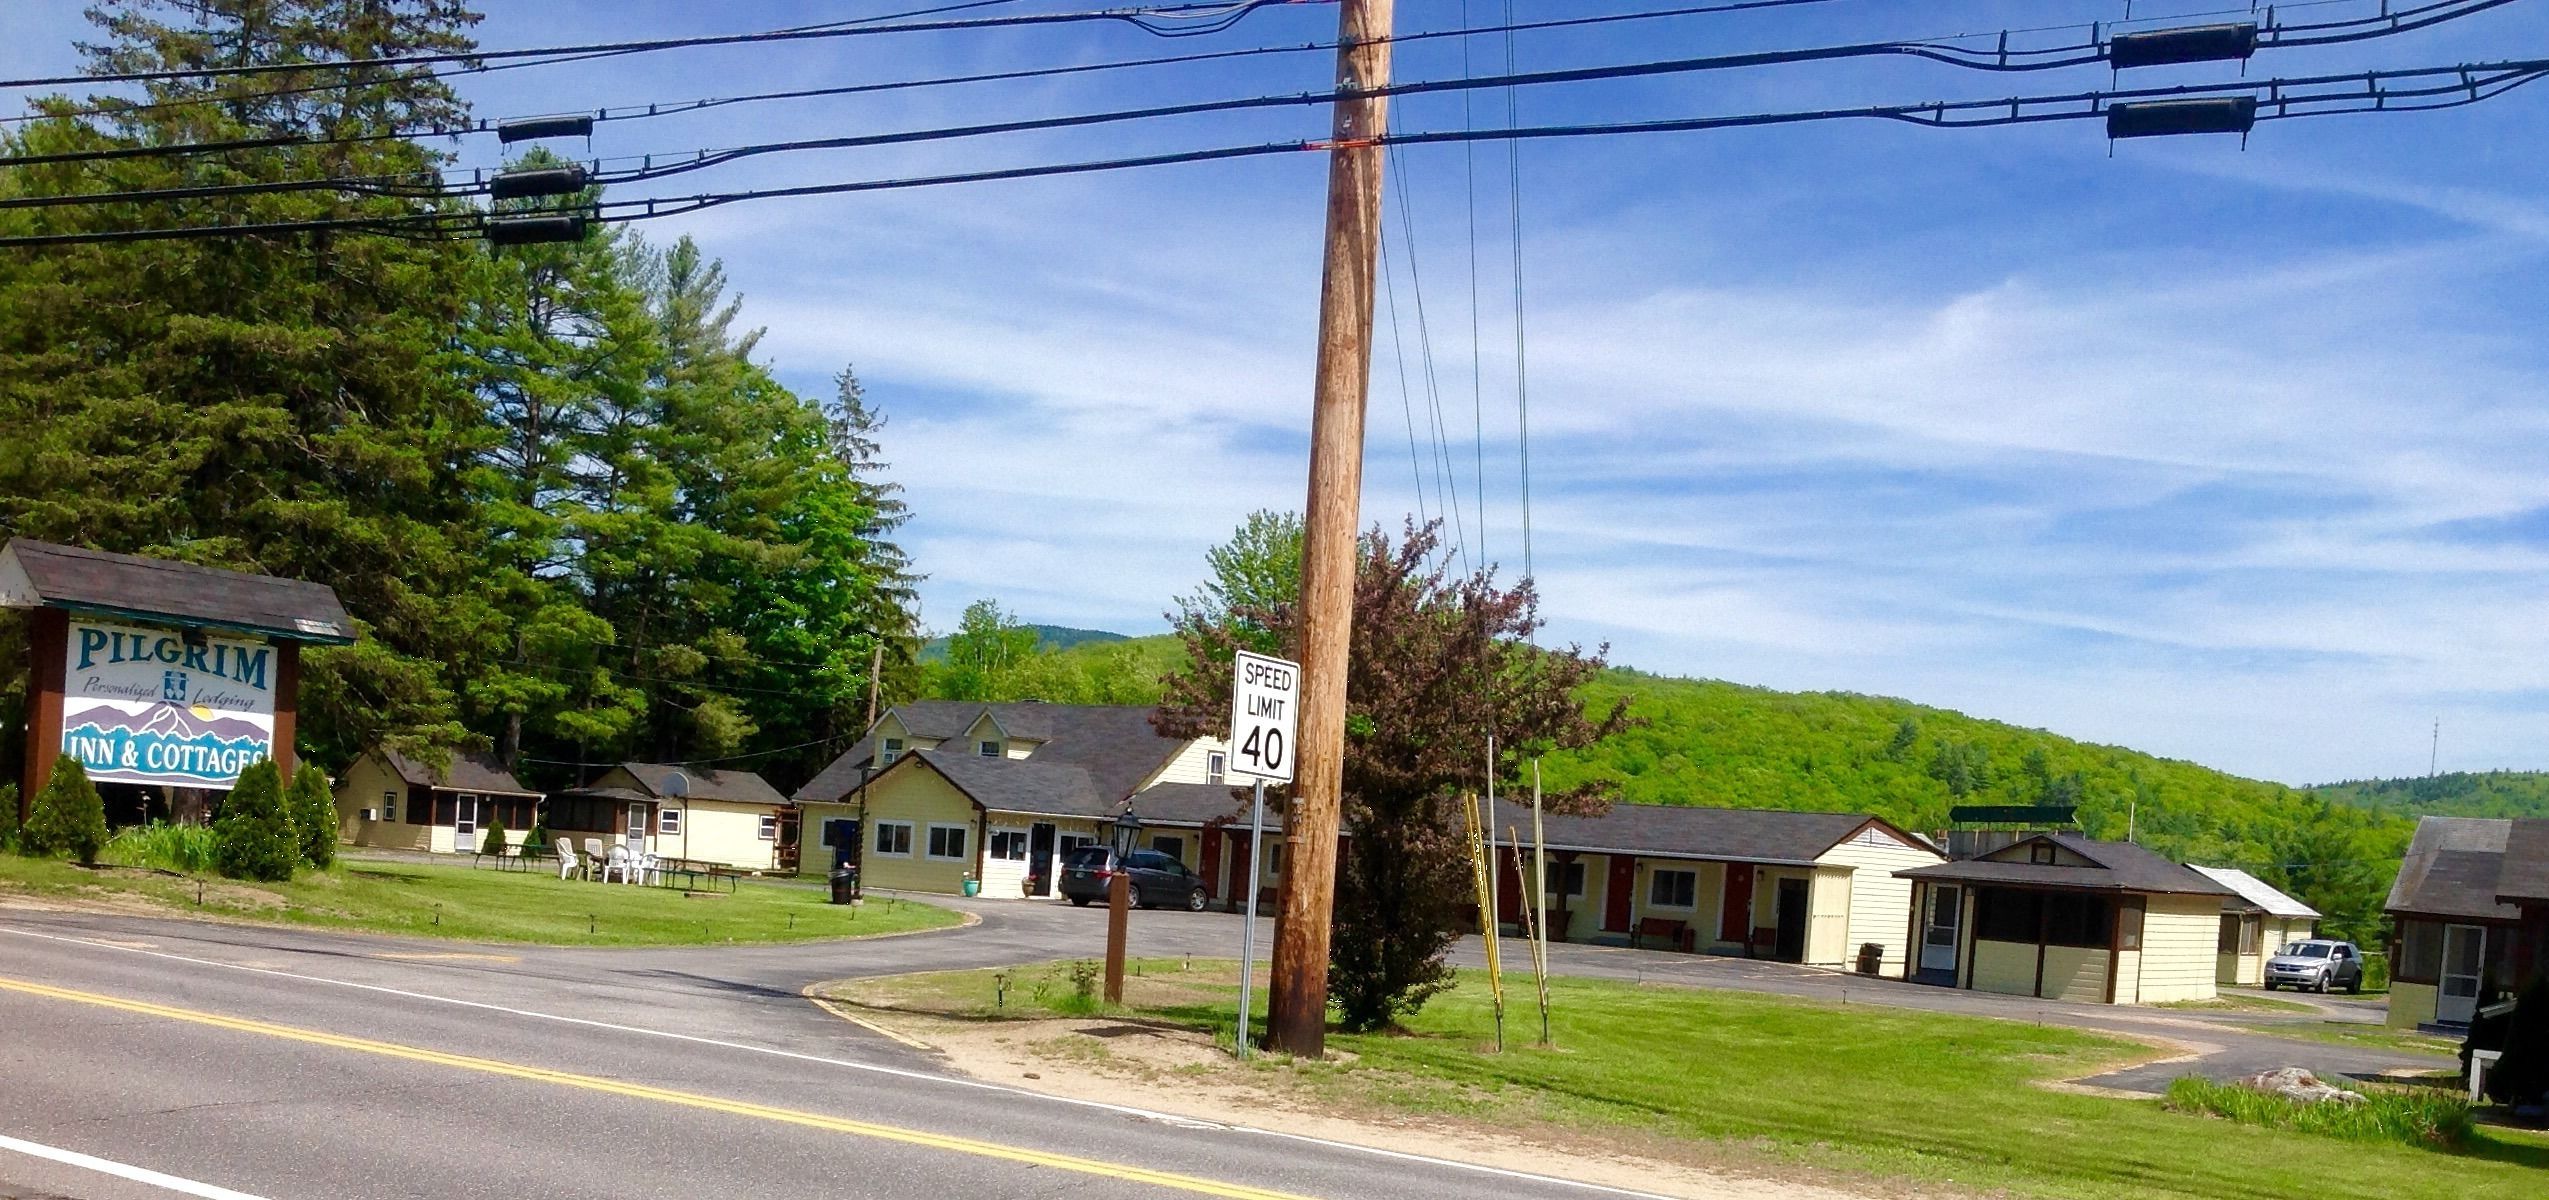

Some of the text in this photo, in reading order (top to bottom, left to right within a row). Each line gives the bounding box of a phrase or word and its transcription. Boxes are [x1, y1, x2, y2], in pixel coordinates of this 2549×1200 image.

[76, 627, 271, 691] PILGRIM
[1244, 662, 1292, 692] SPEED
[83, 676, 255, 712] Personalized Lodging
[1247, 693, 1285, 721] LIMIT
[70, 736, 115, 766] INN
[121, 740, 139, 767] &
[1241, 725, 1283, 770] 40
